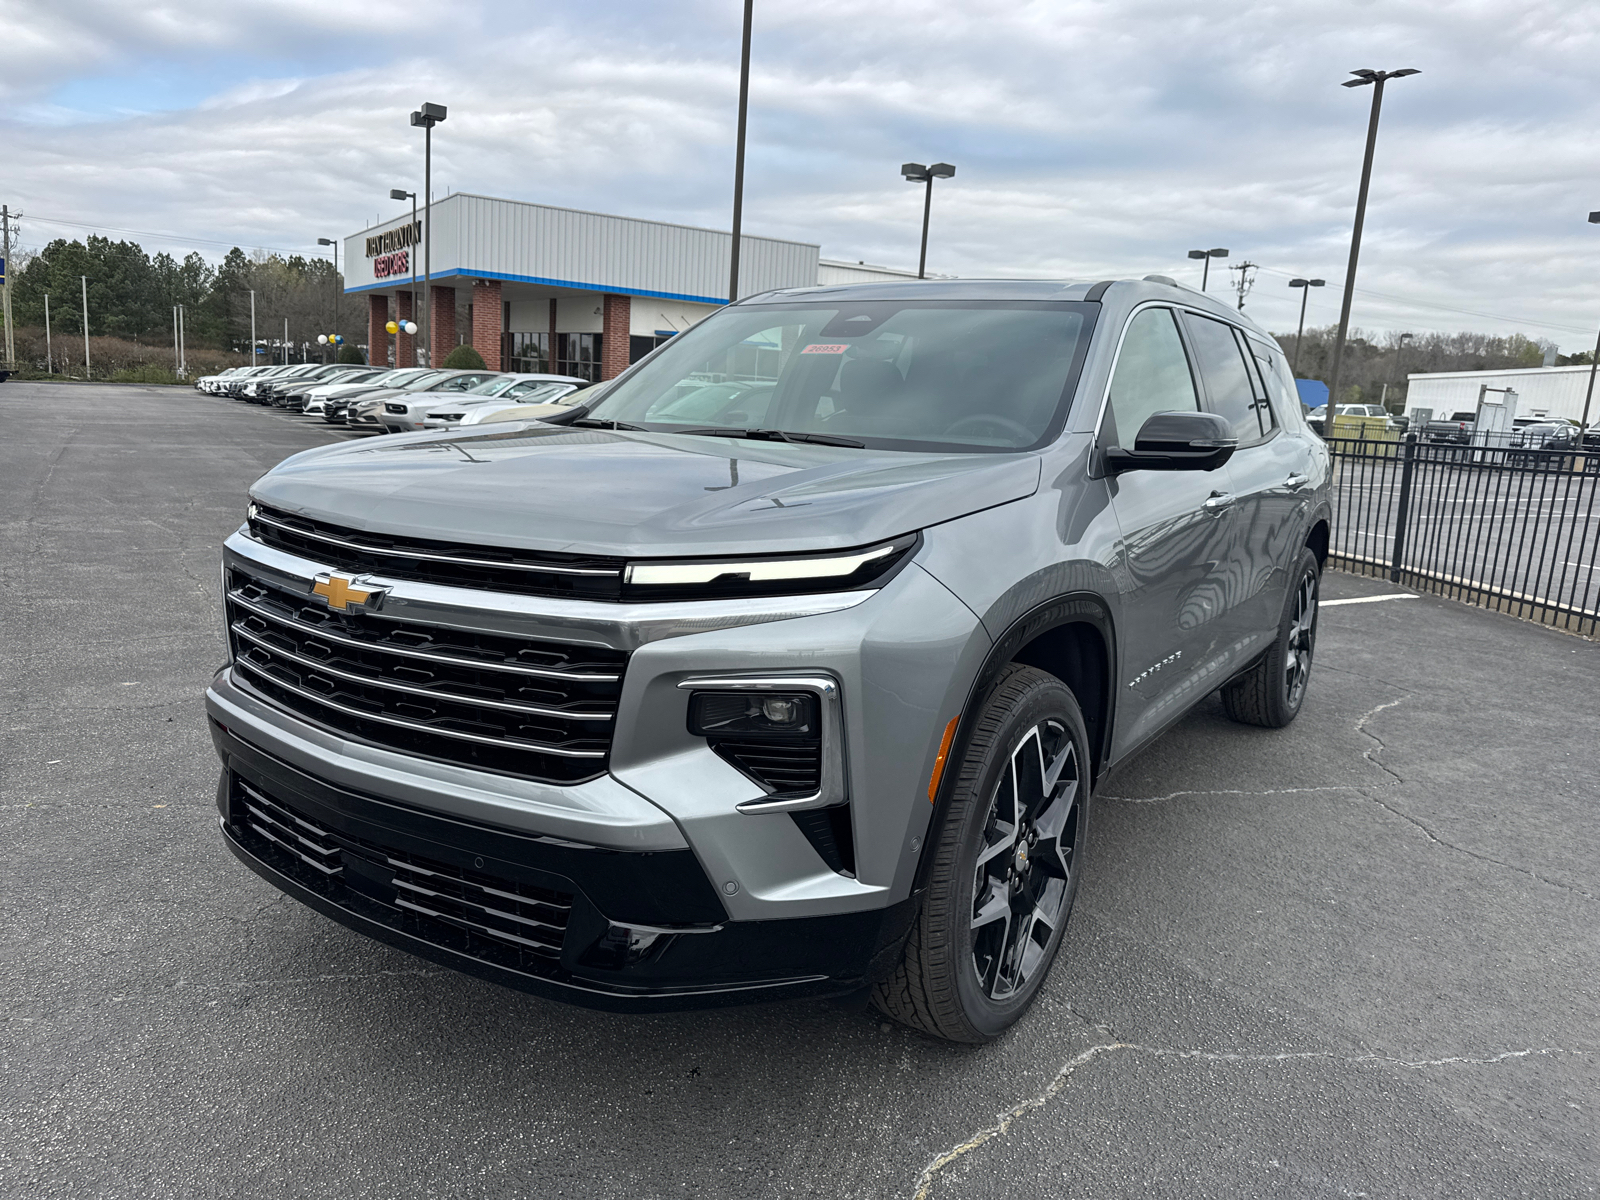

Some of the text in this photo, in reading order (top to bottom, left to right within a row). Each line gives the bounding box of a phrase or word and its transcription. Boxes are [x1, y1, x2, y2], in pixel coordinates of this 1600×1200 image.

[366, 220, 422, 258] JOHN THORNTON
[374, 250, 409, 278] USED CARS
[808, 345, 842, 353] 26953
